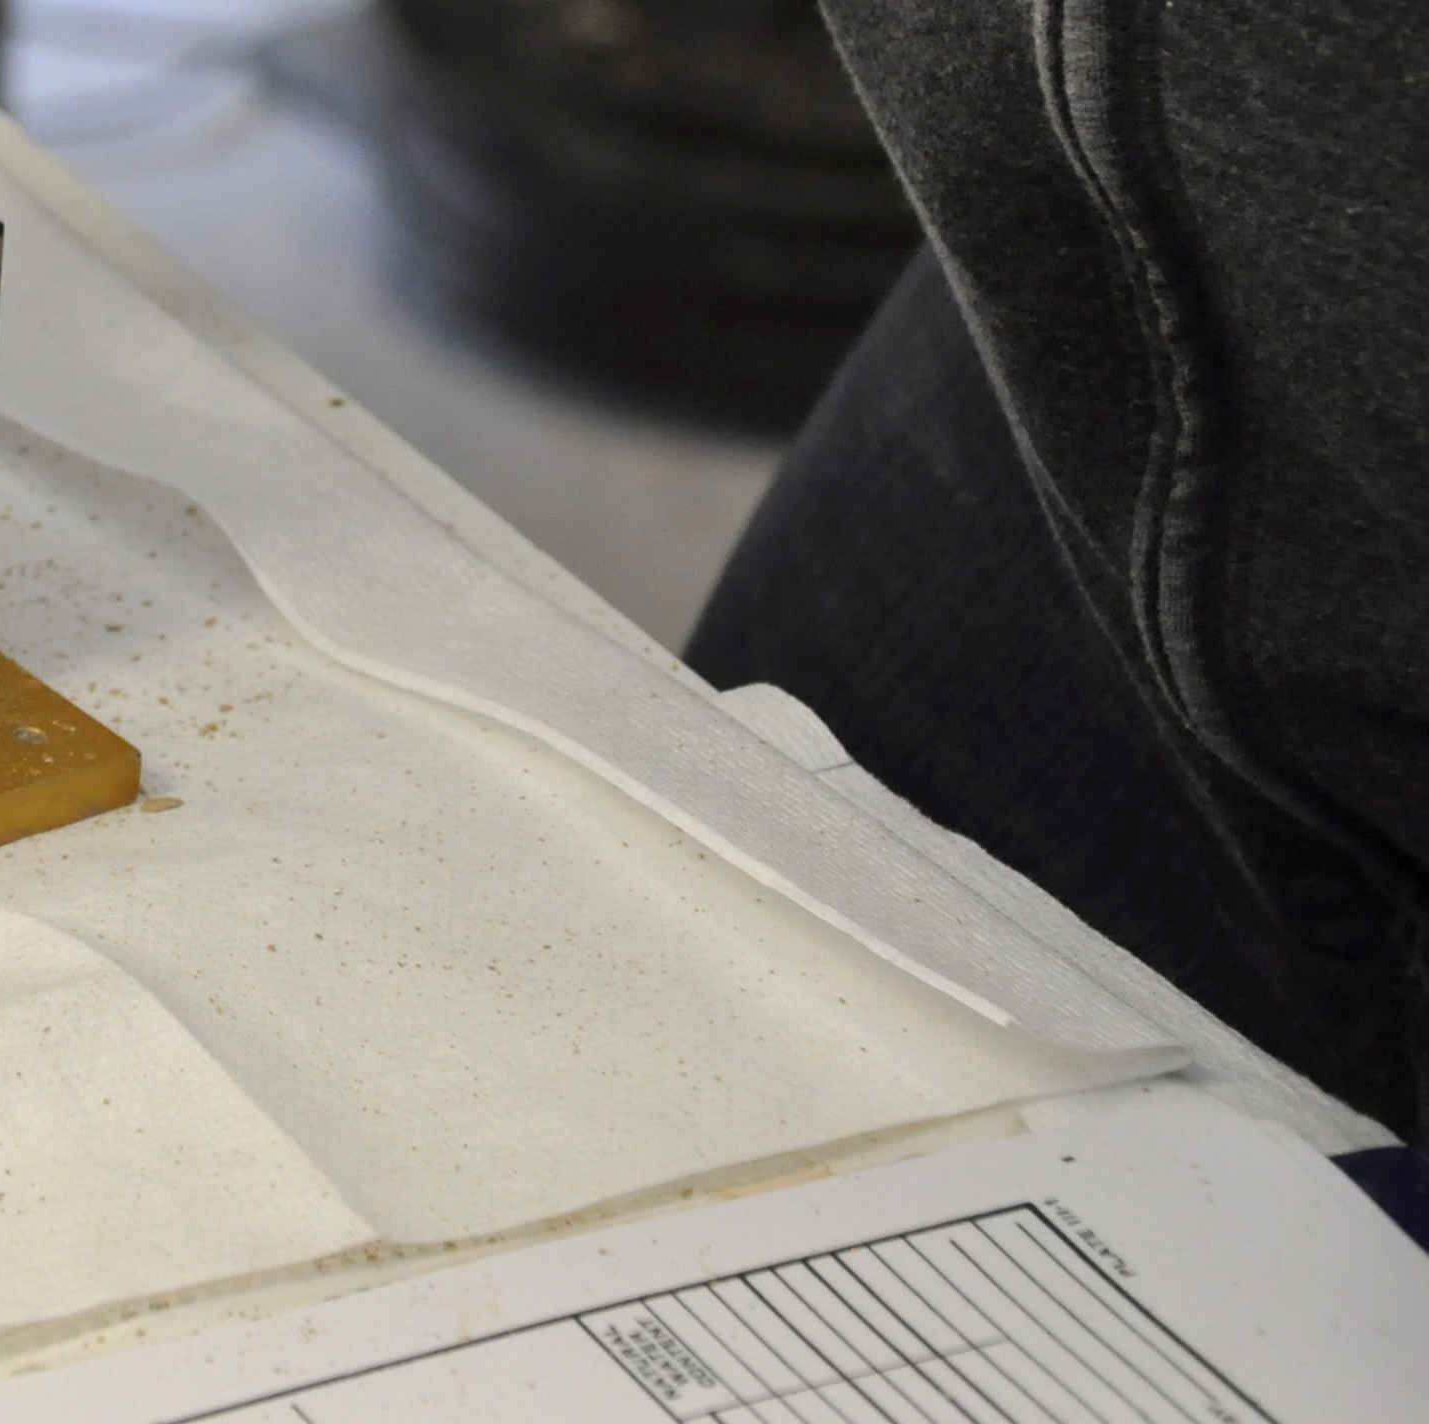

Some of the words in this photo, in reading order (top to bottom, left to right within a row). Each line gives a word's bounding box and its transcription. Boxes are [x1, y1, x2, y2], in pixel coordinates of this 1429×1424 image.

[1077, 1229, 1136, 1277] PLATE
[606, 1323, 681, 1401] NATURAL
[628, 1330, 689, 1386] WATER
[635, 1316, 717, 1389] CONTENT
